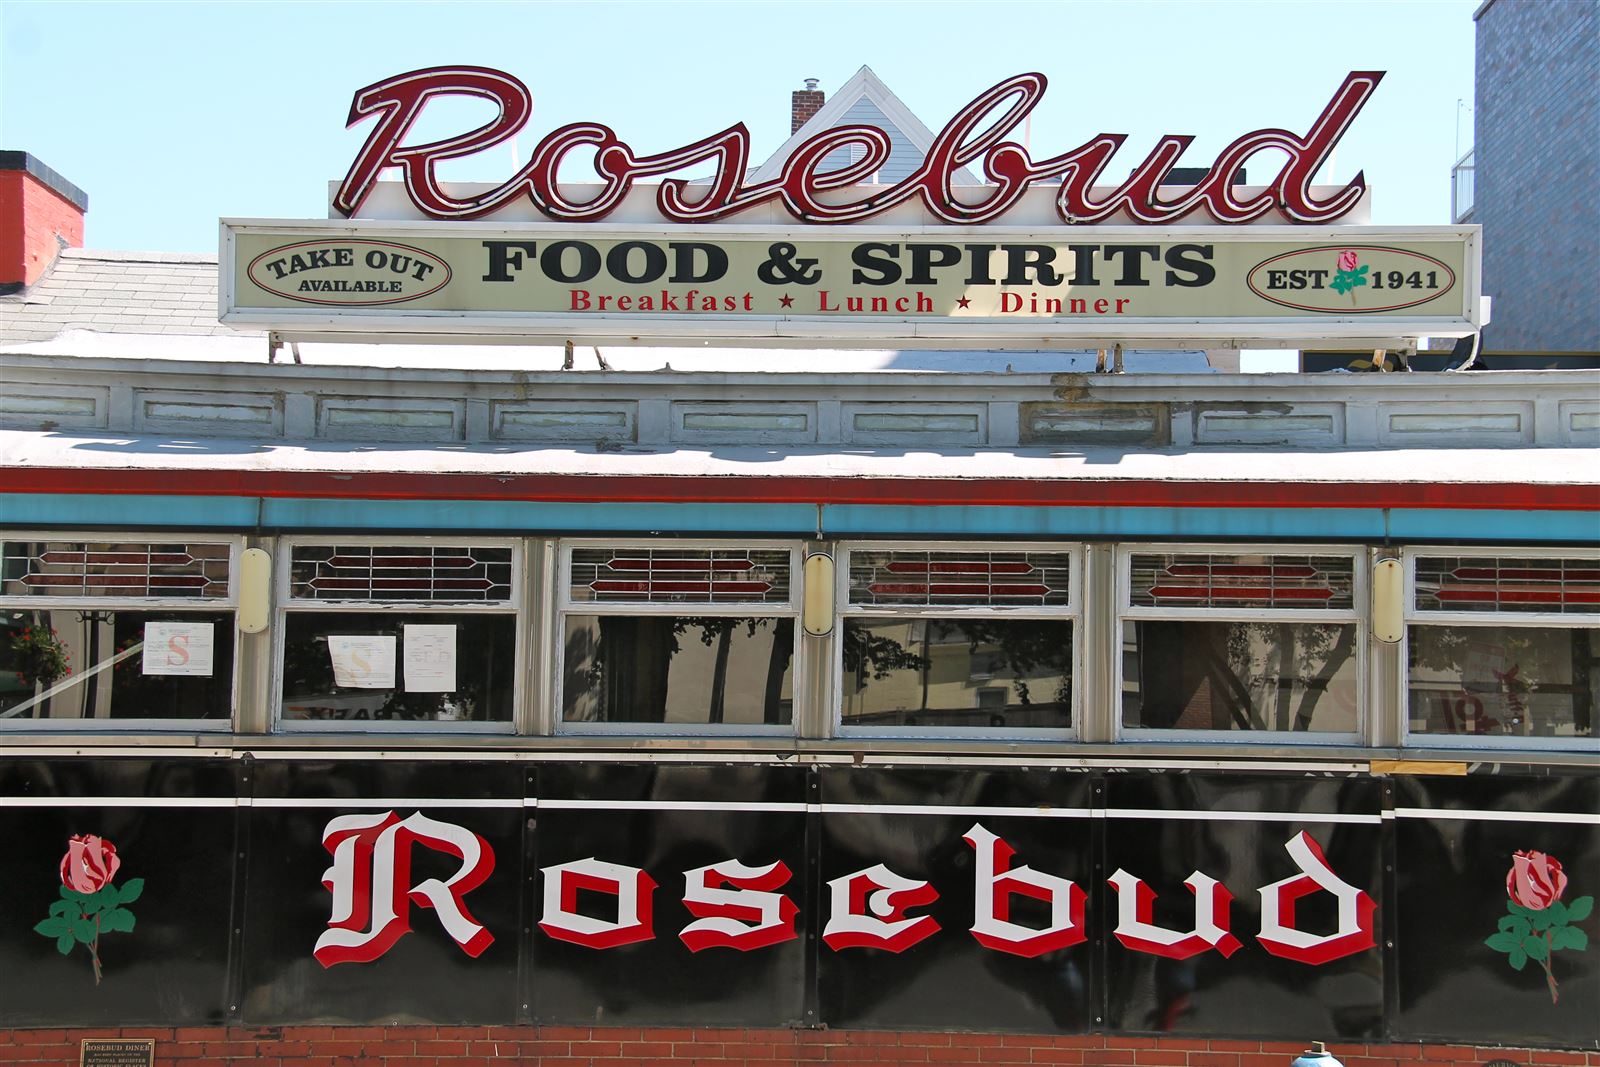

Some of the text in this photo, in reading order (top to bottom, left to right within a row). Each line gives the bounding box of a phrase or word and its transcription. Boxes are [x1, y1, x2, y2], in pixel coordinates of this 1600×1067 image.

[333, 65, 1386, 226] Rosebud
[265, 248, 434, 283] TAKE OUT
[482, 240, 1216, 287] FOOD & SPIRITS
[1266, 269, 1439, 290] EST 1941
[298, 280, 402, 293] AVAILABLE
[569, 290, 1131, 315] Breakfast Lunch Dinner
[166, 634, 189, 667] S
[312, 810, 1379, 969] Rosebud
